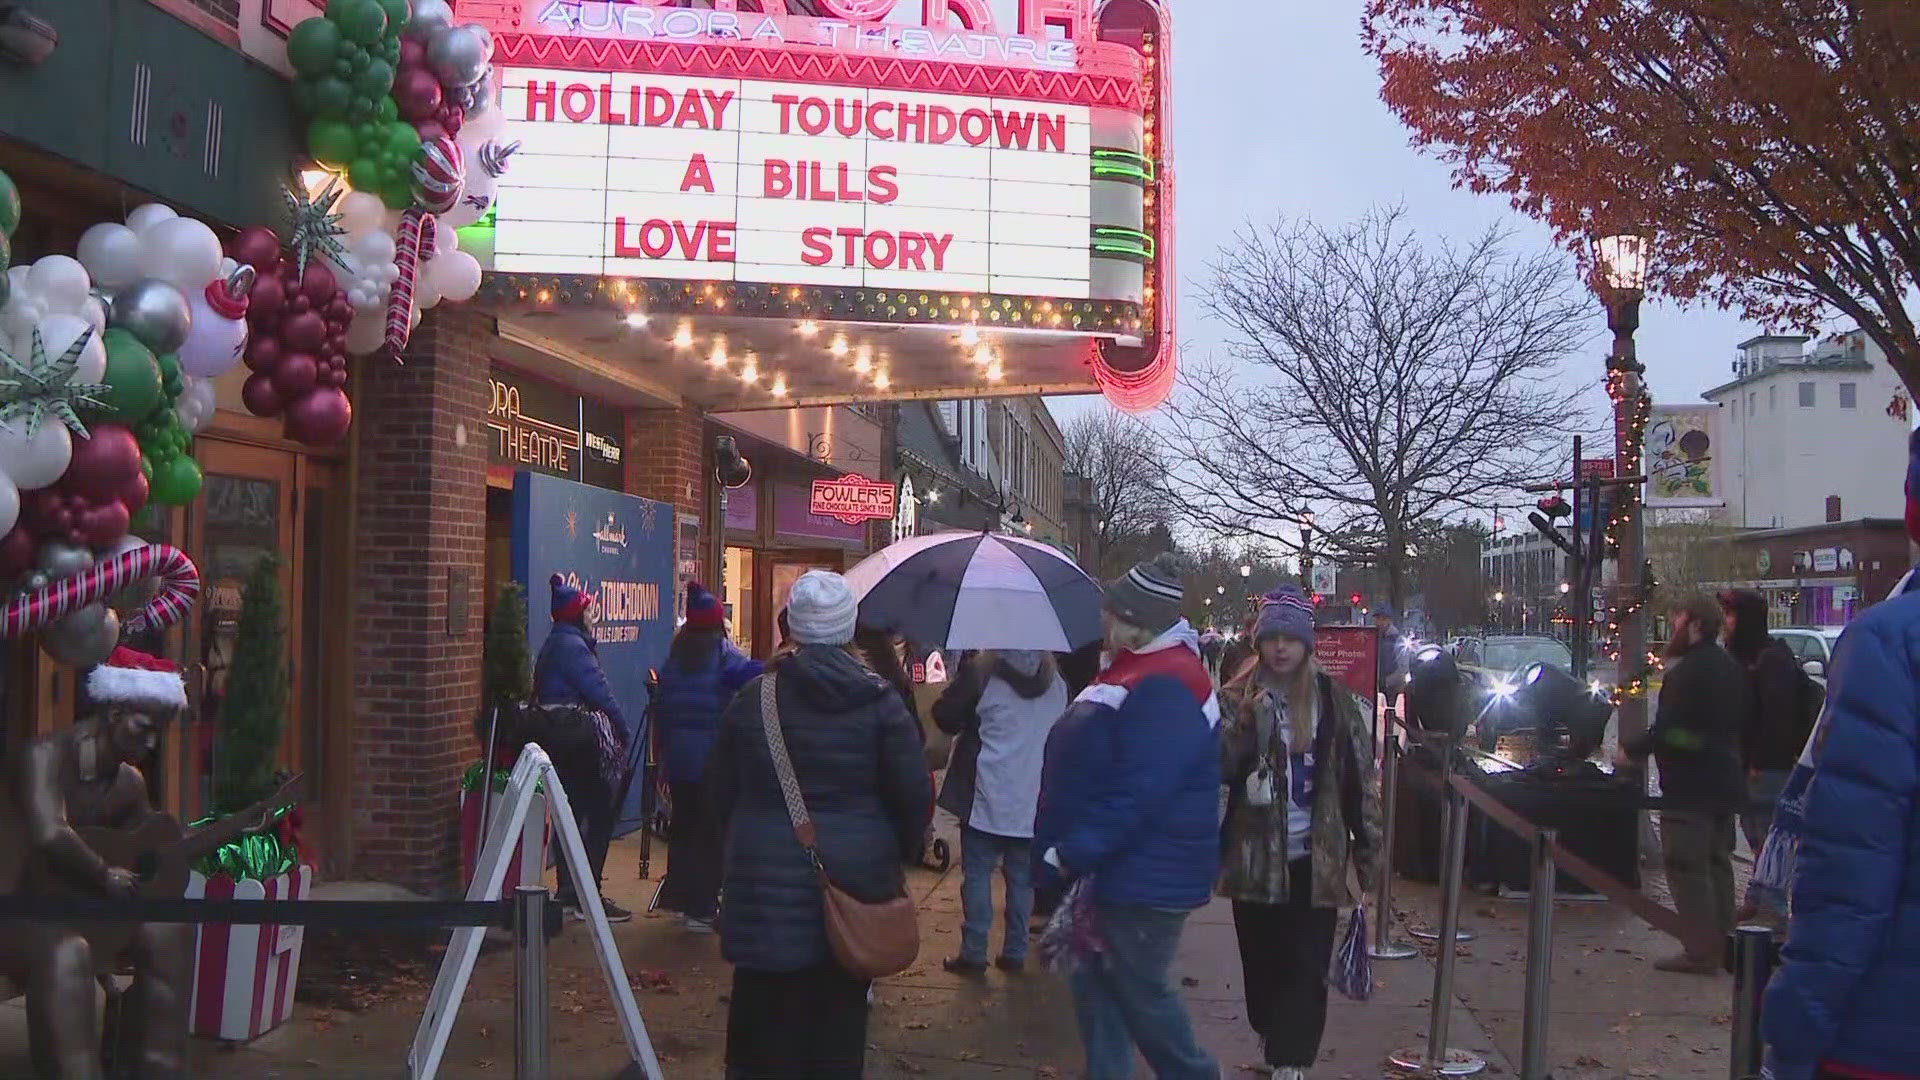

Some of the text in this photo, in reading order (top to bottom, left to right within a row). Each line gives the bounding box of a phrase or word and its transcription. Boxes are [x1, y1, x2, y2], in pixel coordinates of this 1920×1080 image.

[538, 0, 785, 43] AURORA
[818, 22, 1076, 67] THEATRE
[525, 80, 1066, 153] HOLIDAY TOUCHDOWN
[680, 153, 899, 204] A BILLS
[615, 216, 954, 271] LOVE STORY
[489, 423, 569, 471] THEATRE
[585, 432, 604, 450] WEST
[602, 443, 620, 460] HERR
[812, 501, 892, 514] FINE CHOCOLATE SINCE 1910
[813, 485, 893, 505] FOWLER'S
[592, 521, 630, 551] Hallmark
[601, 581, 659, 621] TOUCHDOWN
[1317, 649, 1367, 658] Your Photos
